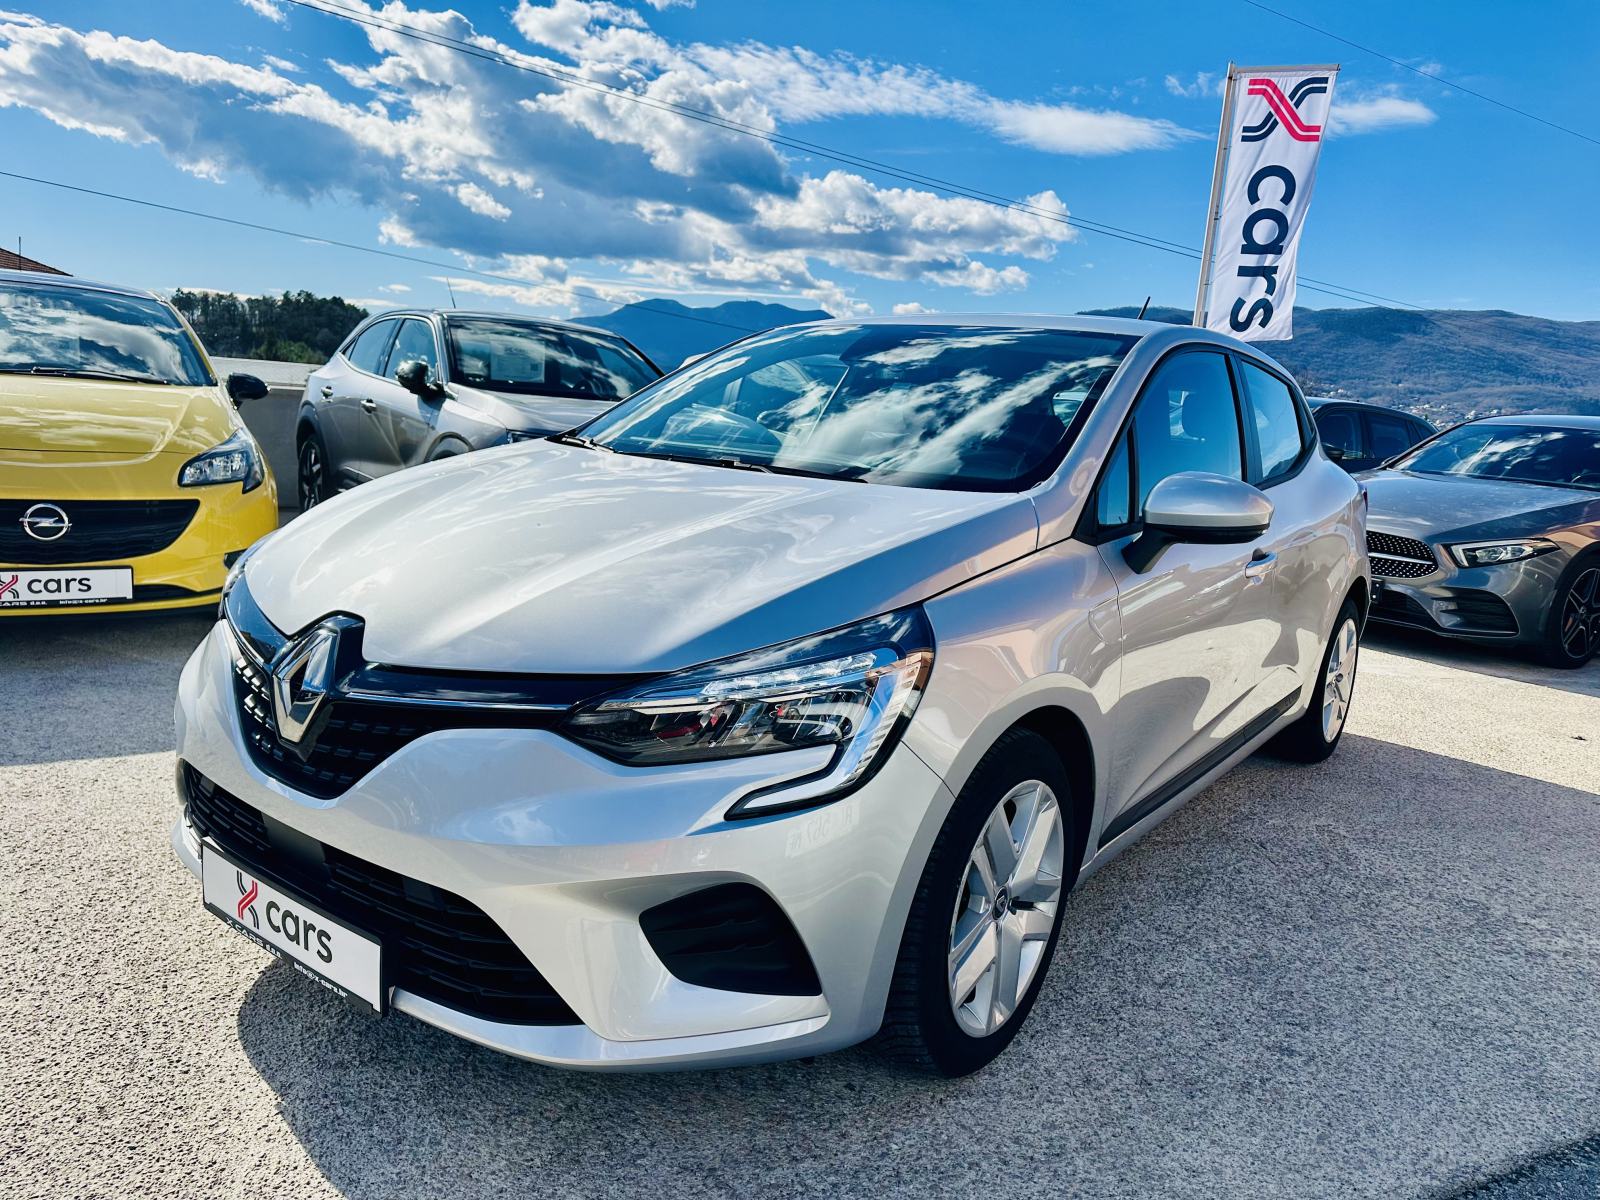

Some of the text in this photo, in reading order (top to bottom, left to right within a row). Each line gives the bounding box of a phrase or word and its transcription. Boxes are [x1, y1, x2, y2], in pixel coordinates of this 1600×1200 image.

[1229, 165, 1296, 333] cars
[27, 577, 92, 594] cars
[265, 900, 333, 963] cars
